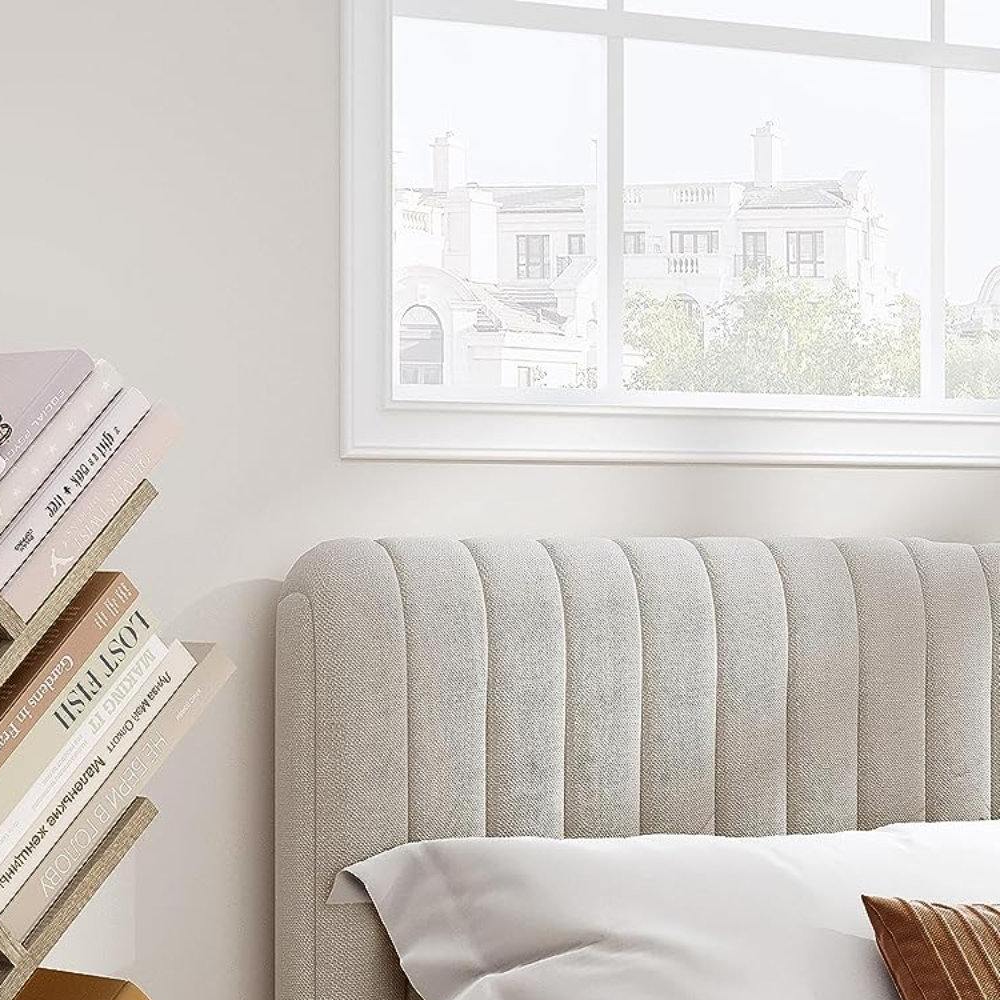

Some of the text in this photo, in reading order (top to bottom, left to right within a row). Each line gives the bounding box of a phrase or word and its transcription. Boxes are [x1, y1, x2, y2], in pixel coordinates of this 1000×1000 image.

[30, 388, 65, 428] SOCIAL
[93, 430, 119, 458] girl
[93, 609, 153, 678] LOST
[26, 653, 76, 710] Gardens
[49, 669, 104, 732] FISH
[100, 647, 158, 714] MAKING
[15, 705, 34, 724] in
[84, 710, 106, 734] IT
[103, 718, 135, 754] Олкотт
[139, 729, 169, 761] НЕ
[44, 755, 106, 828] Маленькие
[102, 754, 149, 807] БЕРИ
[91, 803, 112, 823] В
[34, 818, 100, 897] ГОЛОВУ
